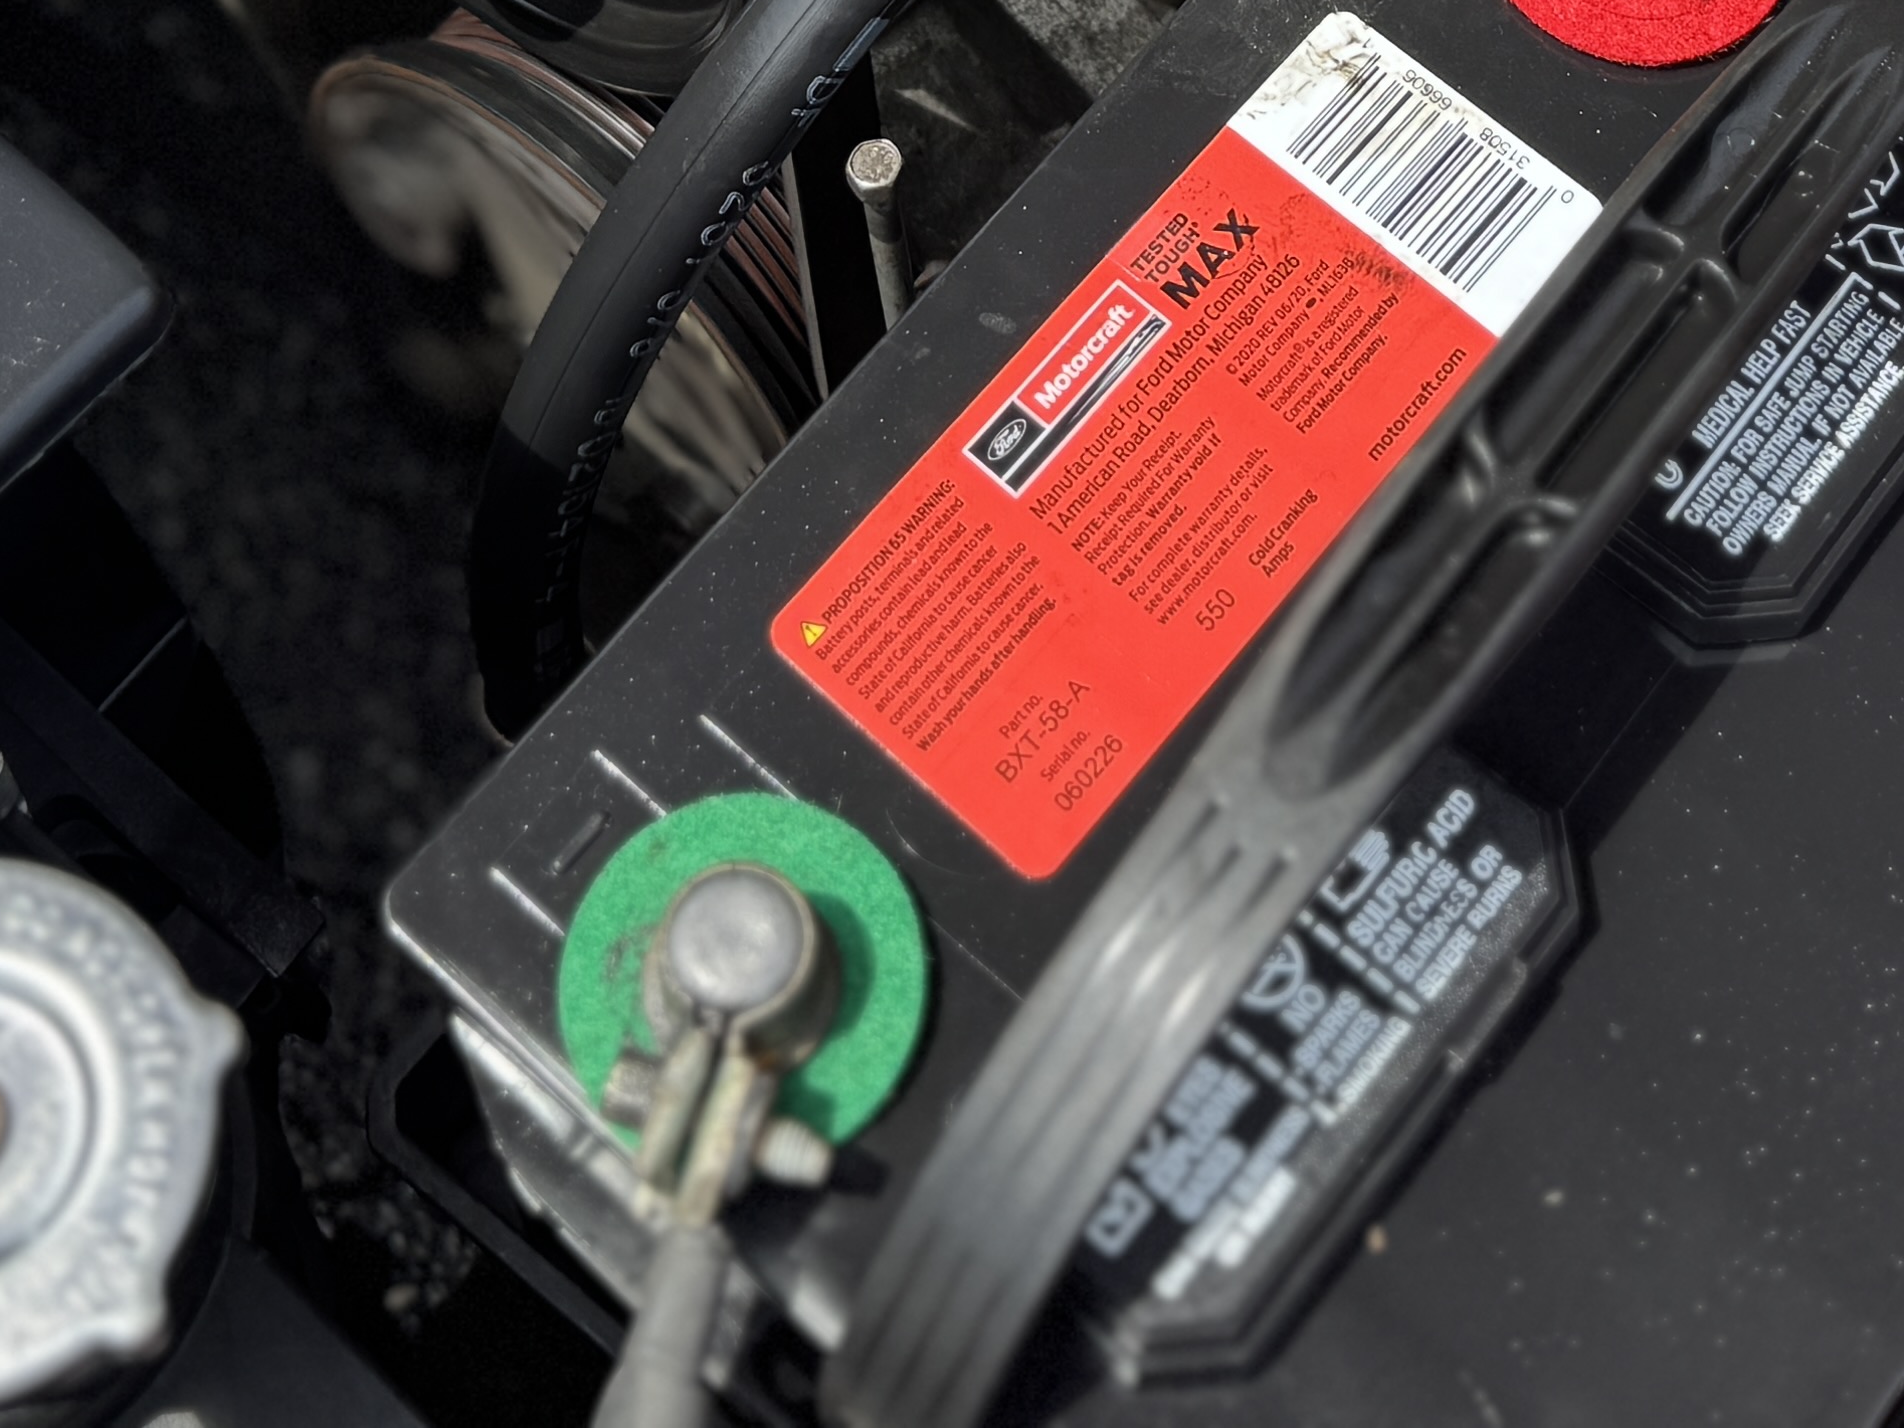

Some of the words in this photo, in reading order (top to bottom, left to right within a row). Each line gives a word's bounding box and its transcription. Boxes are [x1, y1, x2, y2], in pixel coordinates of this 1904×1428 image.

[1402, 69, 1452, 110] 66606
[1479, 126, 1530, 169] 31508
[1129, 212, 1188, 271] TESTED
[1160, 209, 1258, 308] MAX
[987, 418, 1026, 460] Ford
[1034, 305, 1132, 408] Motorcraft
[1029, 413, 1124, 525] Manufactured
[1117, 392, 1144, 419] for
[1135, 355, 1173, 396] Ford
[1164, 316, 1210, 362] Motor
[1203, 251, 1267, 320] Company
[1057, 459, 1120, 528] American
[1111, 419, 1156, 462] Road,
[1146, 356, 1214, 422] Dearborn,
[1205, 295, 1265, 356] Michigan
[1259, 253, 1300, 296] 48126
[1368, 348, 1466, 460] motorcraft.com
[1683, 461, 1740, 525] CAUTION:
[1730, 428, 1764, 463] FOR
[1754, 391, 1791, 432] SAFE
[1784, 355, 1816, 397] JUMP
[1810, 291, 1869, 358] STARTING
[1692, 380, 1754, 447] MEDICAL
[1740, 338, 1780, 383] HELP
[1771, 300, 1810, 344] FAST
[1706, 473, 1757, 535] FOLLOW
[1749, 380, 1834, 478] INSTRUCTIONS
[1821, 361, 1844, 383] IN
[1833, 309, 1883, 364] VEHICLE
[1722, 491, 1778, 554] OWNERS
[1767, 437, 1821, 495] MANUAL.
[1811, 413, 1831, 436] IF
[1823, 383, 1855, 419] NOT
[1848, 319, 1904, 388] AVAILABLE
[1247, 535, 1275, 567] Cold
[1269, 488, 1318, 544] Cranking
[1763, 498, 1801, 541] SEEK
[1791, 441, 1844, 503] SERVICE
[821, 545, 893, 623] PROPOSITION
[887, 530, 906, 550] 65
[900, 479, 955, 534] WARNING:
[1261, 540, 1294, 578] Amps
[1195, 588, 1235, 631] 550
[994, 681, 1090, 782] BXT-58-A
[998, 709, 1027, 739] Part
[1022, 694, 1044, 714] no.
[1039, 743, 1075, 782] Serial
[1069, 730, 1091, 750] no.
[1053, 734, 1122, 811] 060226
[1348, 842, 1441, 946] SULFURIC
[1427, 789, 1473, 847] ACID
[1372, 918, 1412, 963] CAN
[1405, 859, 1458, 920] CAUSE
[1390, 878, 1477, 981] BLINDNESS
[1470, 844, 1502, 879] OR
[1416, 926, 1475, 999] SEVERE
[1467, 865, 1521, 928] BURNS
